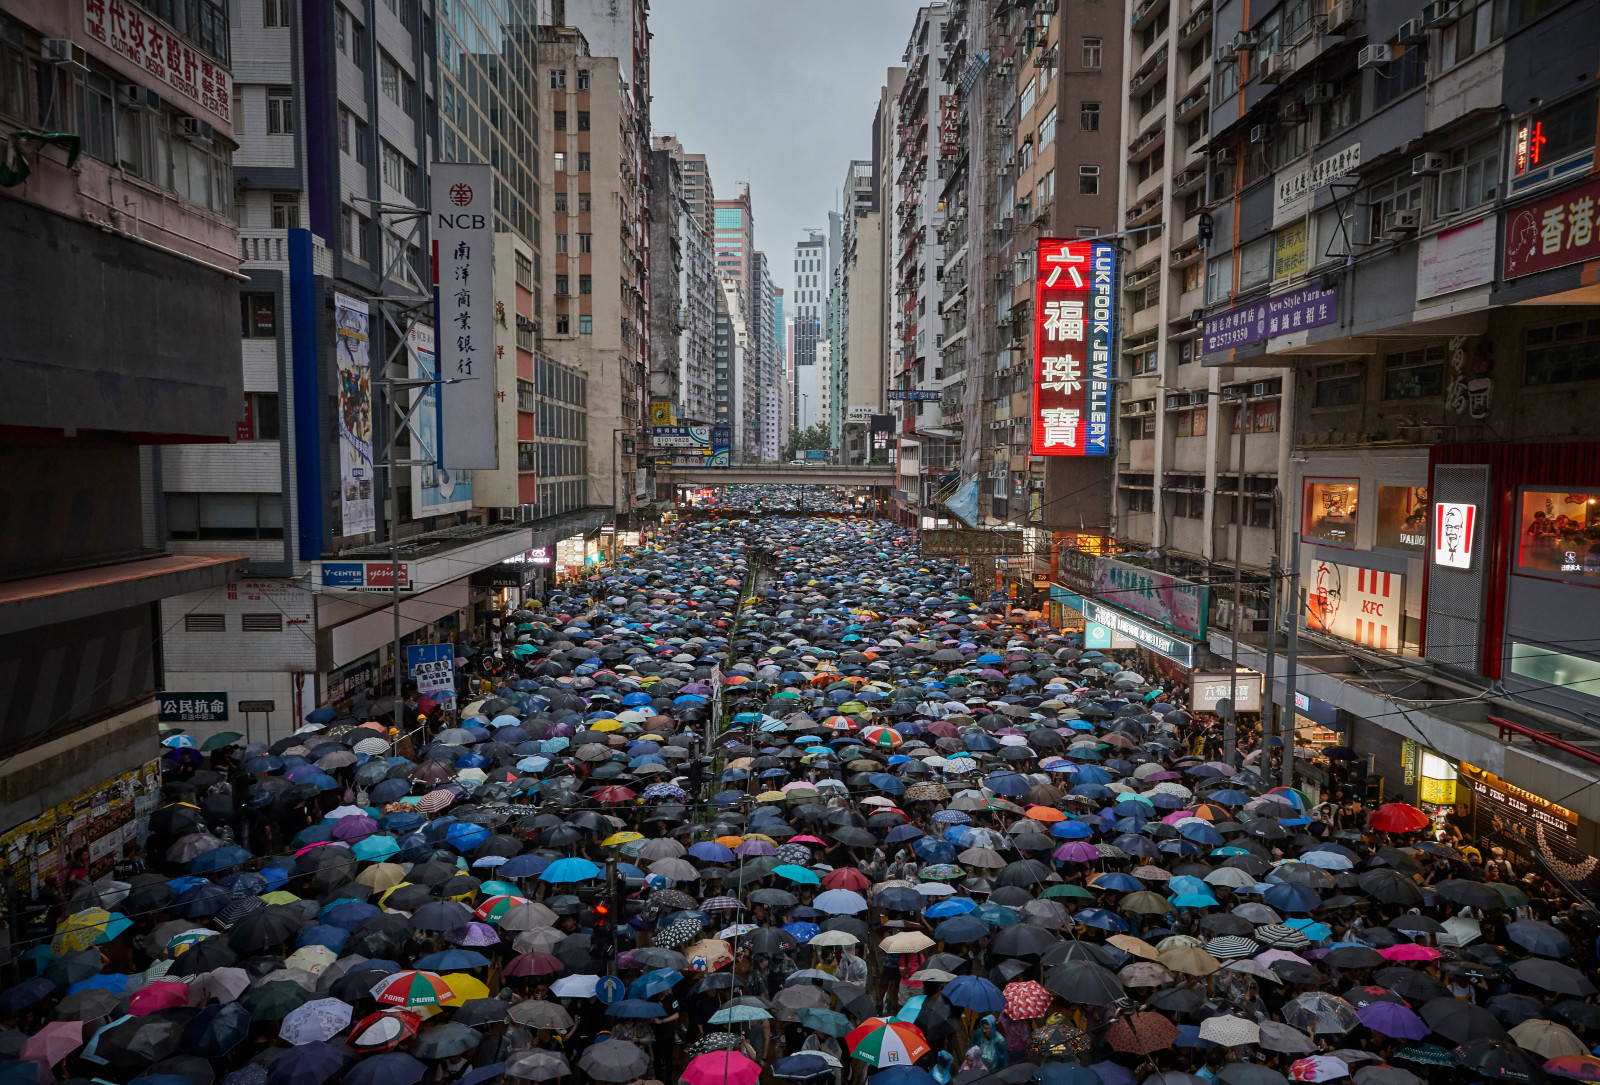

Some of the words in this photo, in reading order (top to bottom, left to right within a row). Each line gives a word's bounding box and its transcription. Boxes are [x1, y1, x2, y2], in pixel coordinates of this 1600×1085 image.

[86, 17, 107, 43] TIMES
[110, 33, 141, 64] CLOTHING
[145, 55, 166, 81] DESIGN
[169, 72, 199, 101] ALTERATION
[438, 214, 486, 230] NCB
[1540, 197, 1600, 256] 香港
[453, 240, 477, 376] 南洋商業銀行
[1093, 247, 1112, 334] LUKFOOK
[1269, 301, 1282, 313] New
[1283, 295, 1301, 309] Style
[1302, 289, 1320, 303] Yarn
[1041, 246, 1084, 448] 六福珠寶
[1090, 339, 1108, 448] JEWELLERY
[227, 583, 238, 600] 招租
[324, 569, 362, 577] Y-CENTER
[368, 567, 407, 580] yesin
[1361, 600, 1384, 617] KFC
[163, 700, 225, 714] 公民抗命
[1474, 781, 1487, 794] LAO
[1489, 788, 1505, 802] FENG
[1508, 796, 1528, 813] XIANG
[1531, 808, 1569, 832] JEWELLERY
